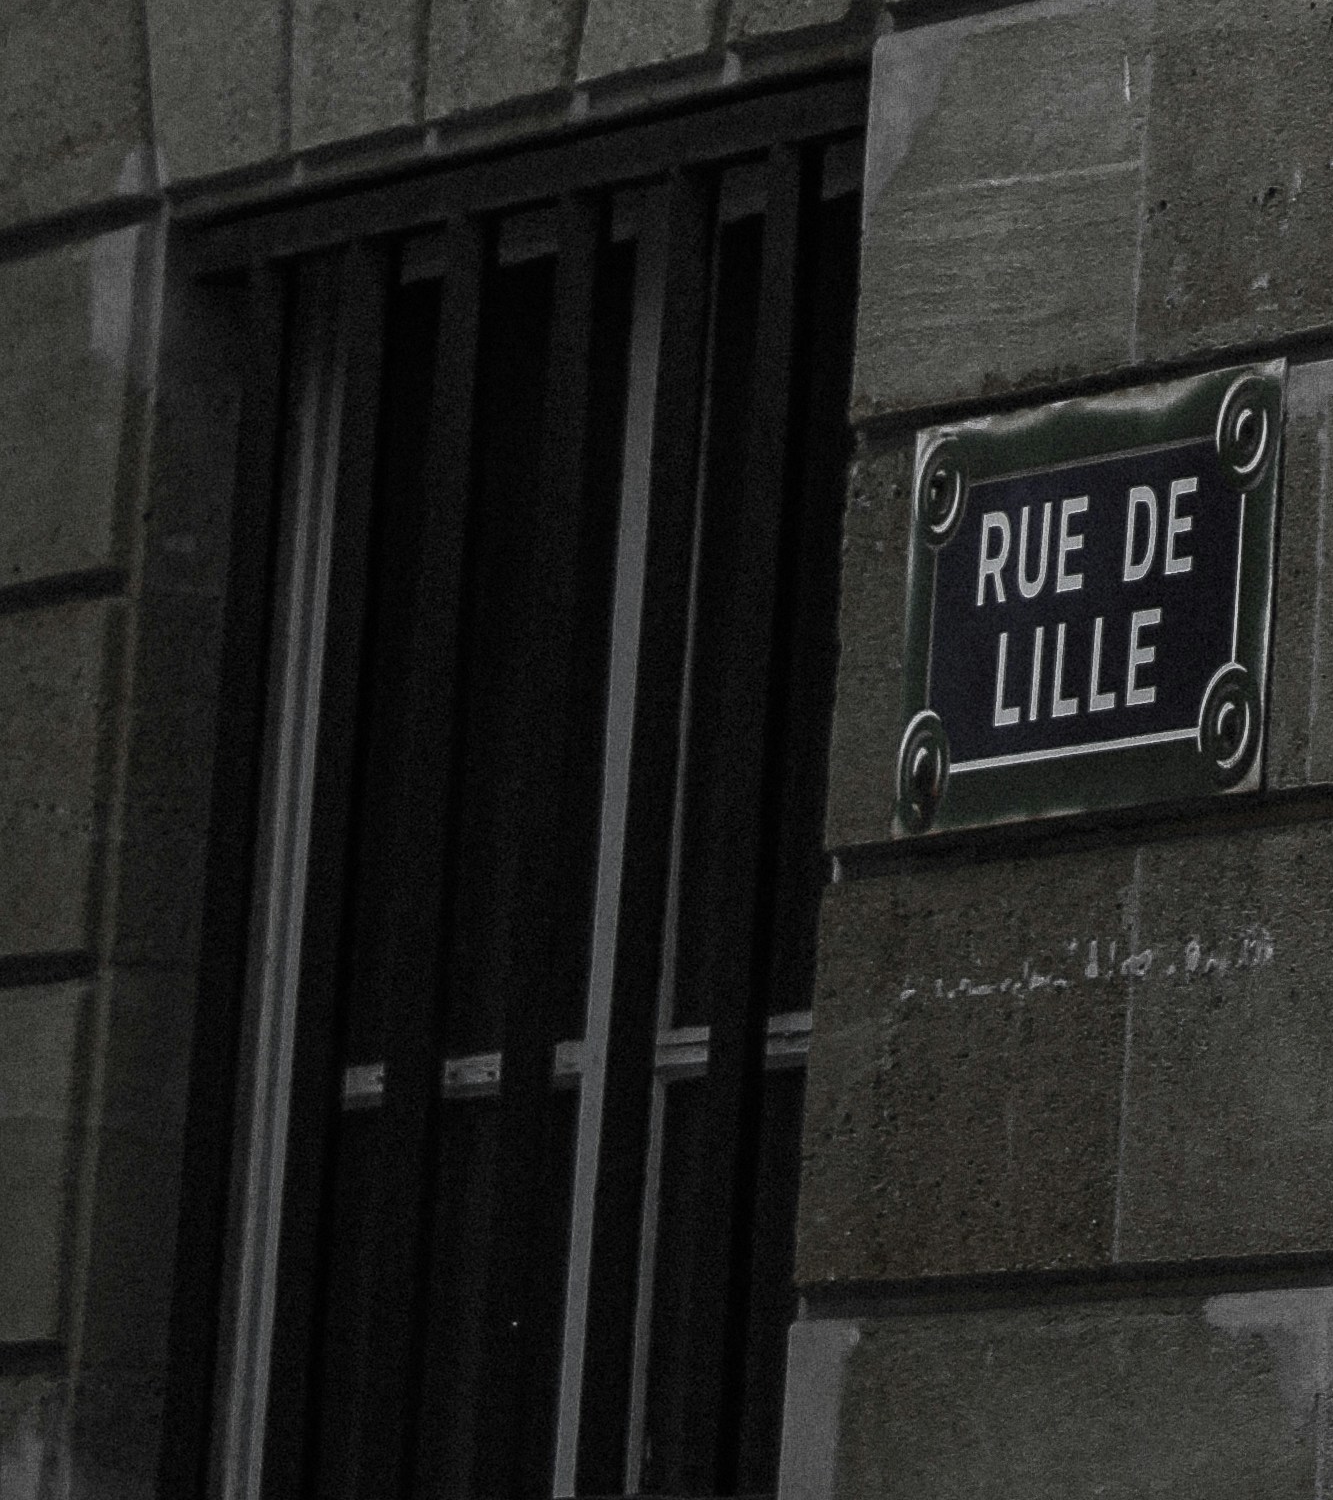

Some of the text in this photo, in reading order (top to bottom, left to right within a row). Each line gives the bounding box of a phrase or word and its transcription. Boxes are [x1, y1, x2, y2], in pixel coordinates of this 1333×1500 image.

[976, 476, 1199, 607] RUE DE
[993, 606, 1164, 728] LILLE
